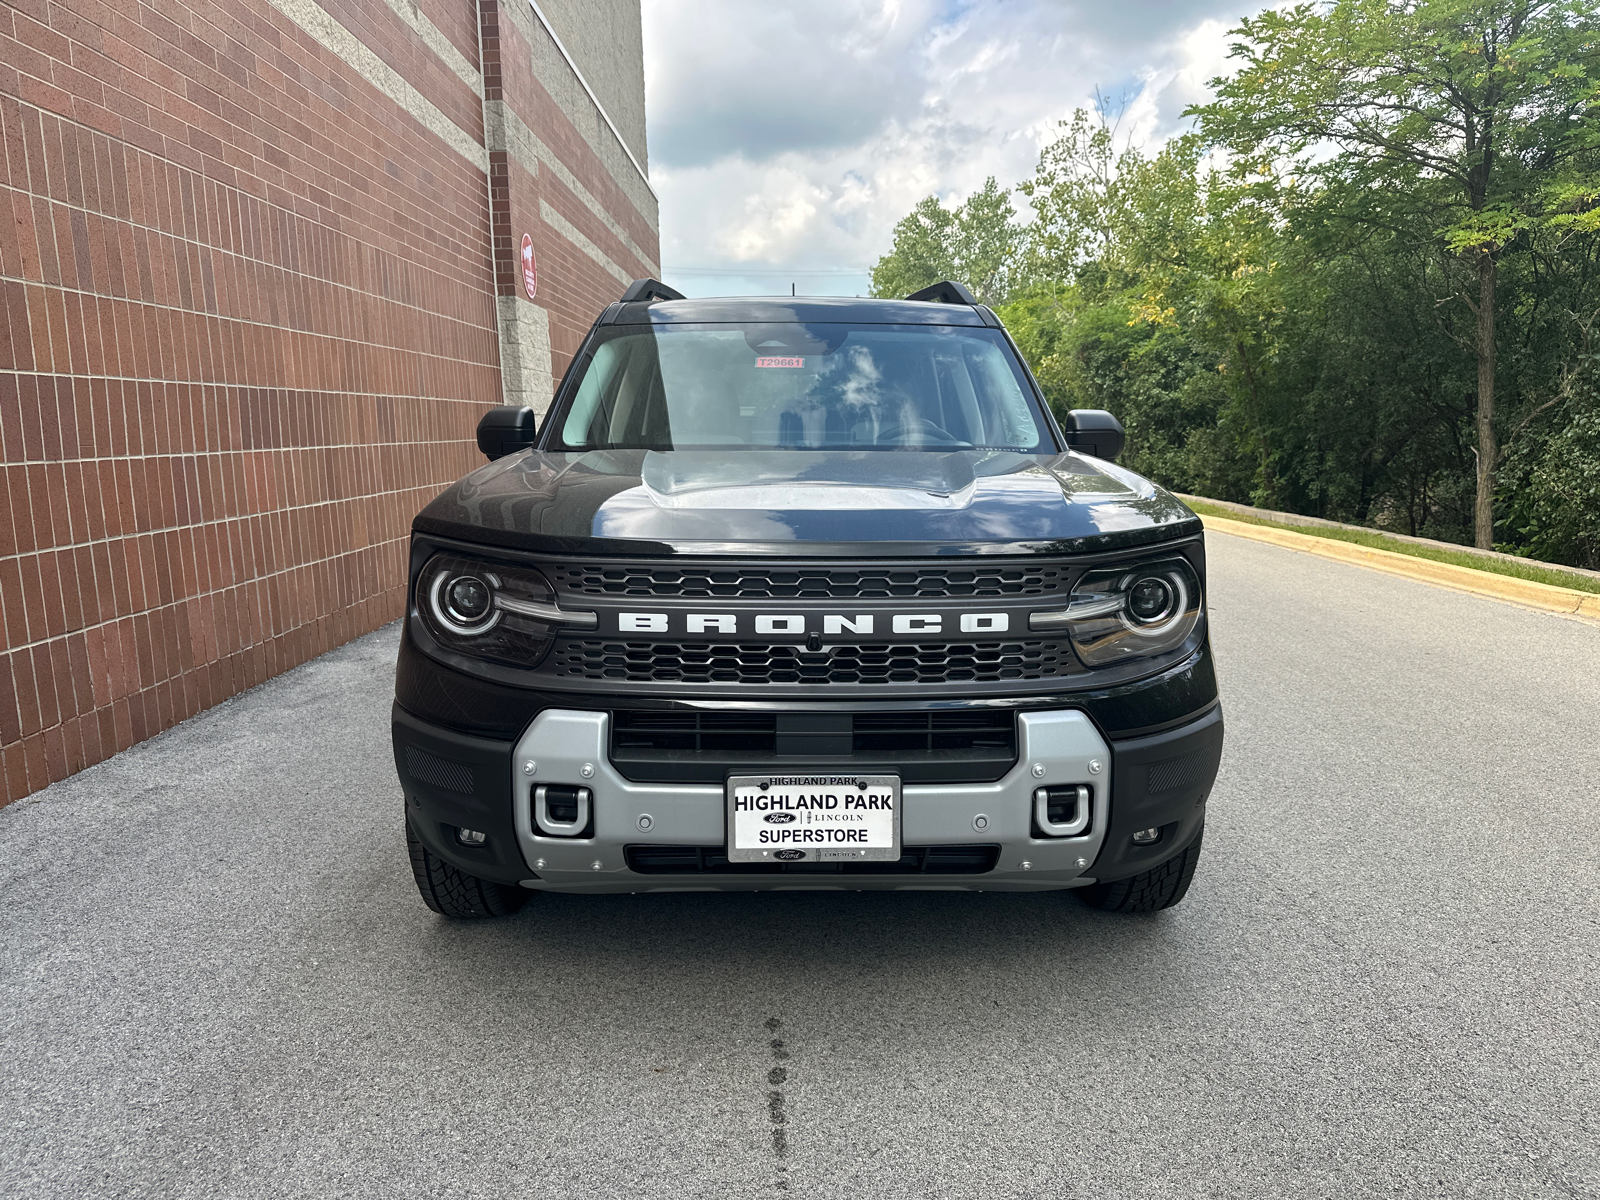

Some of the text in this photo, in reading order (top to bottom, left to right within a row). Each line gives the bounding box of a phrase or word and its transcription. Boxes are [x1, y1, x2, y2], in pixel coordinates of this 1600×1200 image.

[759, 358, 800, 367] T29661
[618, 612, 1009, 634] BRONCO
[769, 777, 858, 786] HIGHLAND PARK
[735, 794, 893, 811] HIGHLAND PARK
[815, 814, 864, 822] LINCOLN
[759, 829, 868, 843] SUPERSTORE
